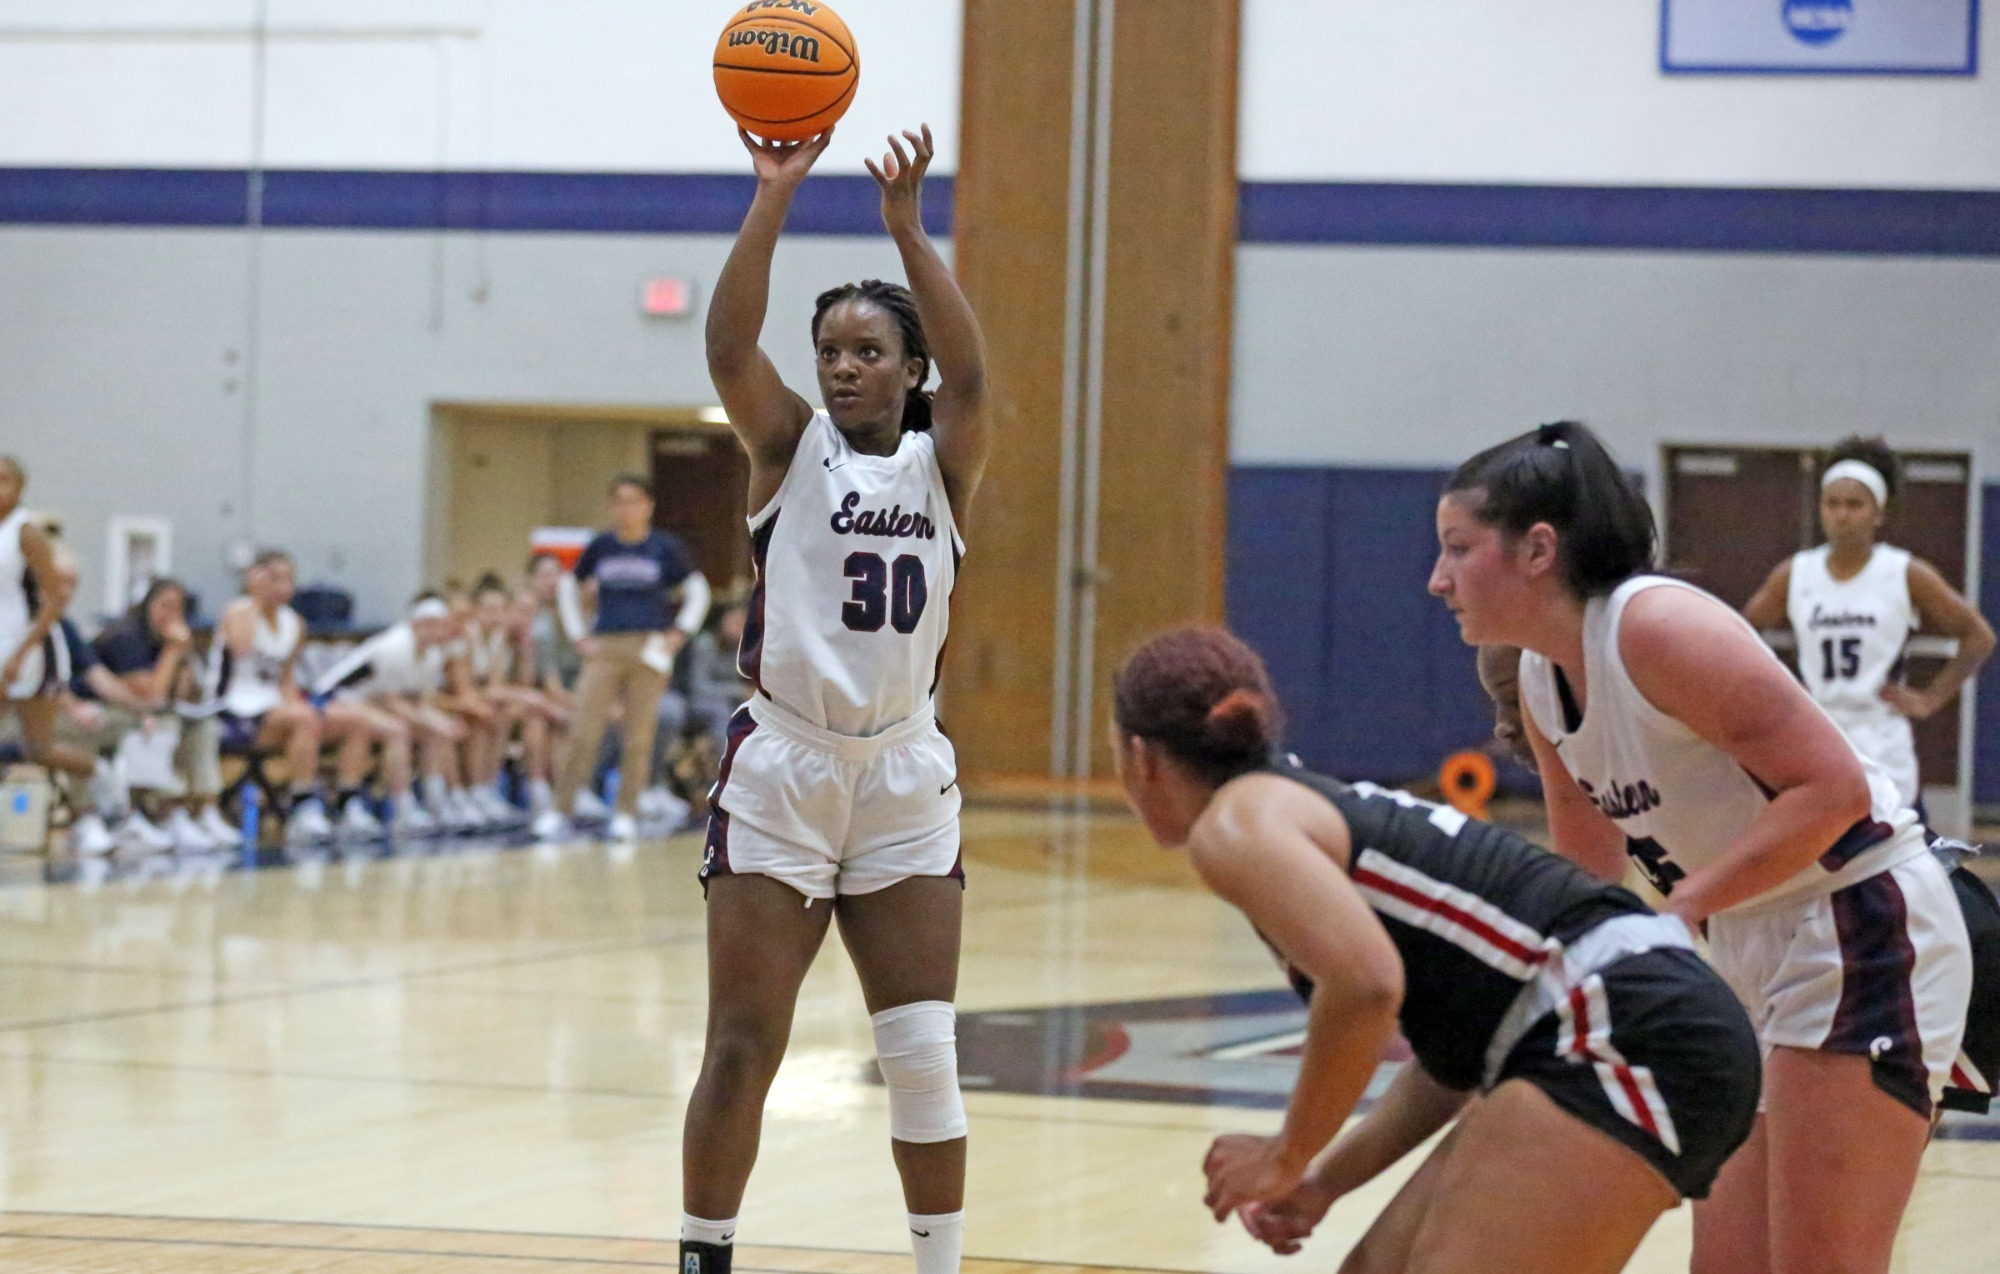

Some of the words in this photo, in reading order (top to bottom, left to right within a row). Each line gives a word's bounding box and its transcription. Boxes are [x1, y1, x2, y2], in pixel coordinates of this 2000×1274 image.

[728, 30, 819, 63] Wilson
[830, 491, 935, 540] Eastern
[842, 551, 928, 634] 30
[1821, 637, 1862, 681] 15
